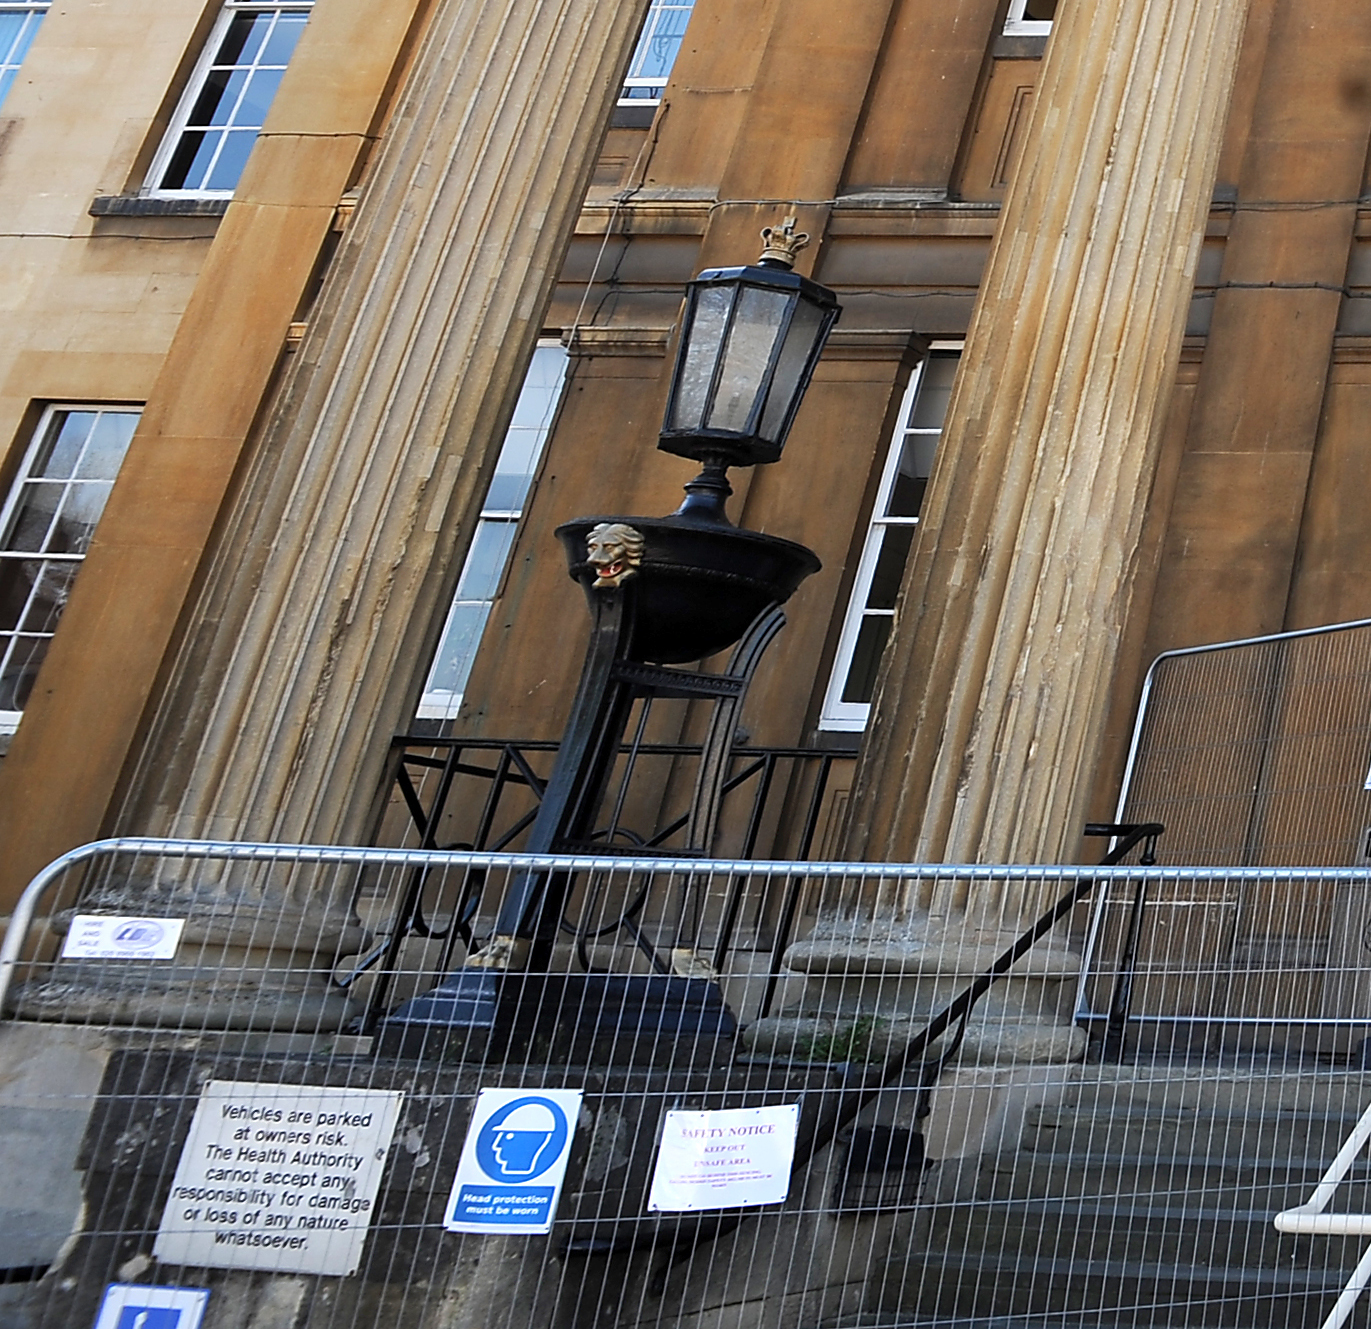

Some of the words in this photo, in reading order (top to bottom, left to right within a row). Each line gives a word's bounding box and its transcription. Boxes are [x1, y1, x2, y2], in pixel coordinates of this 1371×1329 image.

[222, 1105, 282, 1122] Vehicles
[288, 1109, 312, 1123] are
[316, 1112, 372, 1128] parked
[234, 1127, 250, 1140] at
[255, 1132, 310, 1144] owners
[316, 1132, 348, 1146] risk.
[682, 1128, 726, 1138] SAFETY
[728, 1124, 776, 1137] NOTICE
[205, 1145, 232, 1160] The
[237, 1147, 286, 1164] Health
[291, 1151, 363, 1171] Authority
[704, 1145, 727, 1153] KEEP
[205, 1167, 258, 1183] cannot
[263, 1171, 317, 1189] accept
[322, 1177, 350, 1191] any
[173, 1186, 274, 1208] responsibility
[280, 1190, 303, 1206] for
[308, 1194, 370, 1214] damage
[463, 1194, 492, 1203] Head
[492, 1195, 548, 1205] protection
[184, 1206, 200, 1220] or
[204, 1208, 237, 1224] loss
[243, 1211, 261, 1225] of
[265, 1214, 292, 1229] any
[298, 1215, 348, 1231] nature
[466, 1206, 494, 1214] must
[496, 1206, 510, 1214] be
[215, 1230, 308, 1250] whatsoever.
